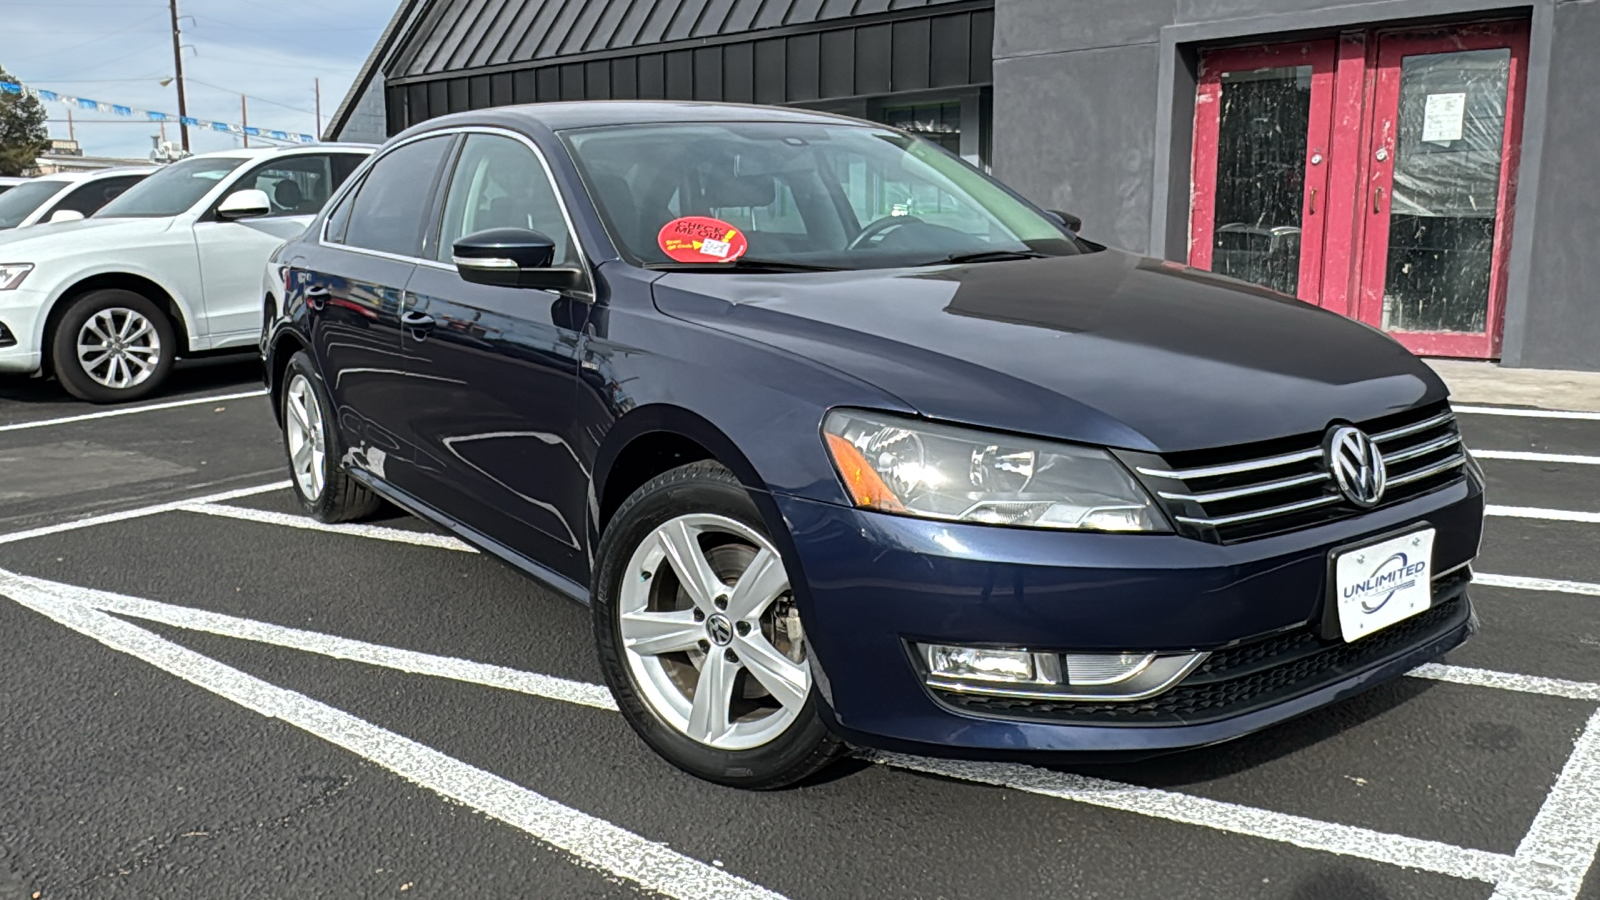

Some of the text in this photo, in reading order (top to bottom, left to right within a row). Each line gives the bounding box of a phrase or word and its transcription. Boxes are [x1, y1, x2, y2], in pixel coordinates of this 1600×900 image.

[676, 227, 693, 235] ME
[677, 222, 722, 233] CHECK
[1332, 428, 1385, 506] VW
[1343, 561, 1425, 598] UNLIMITED
